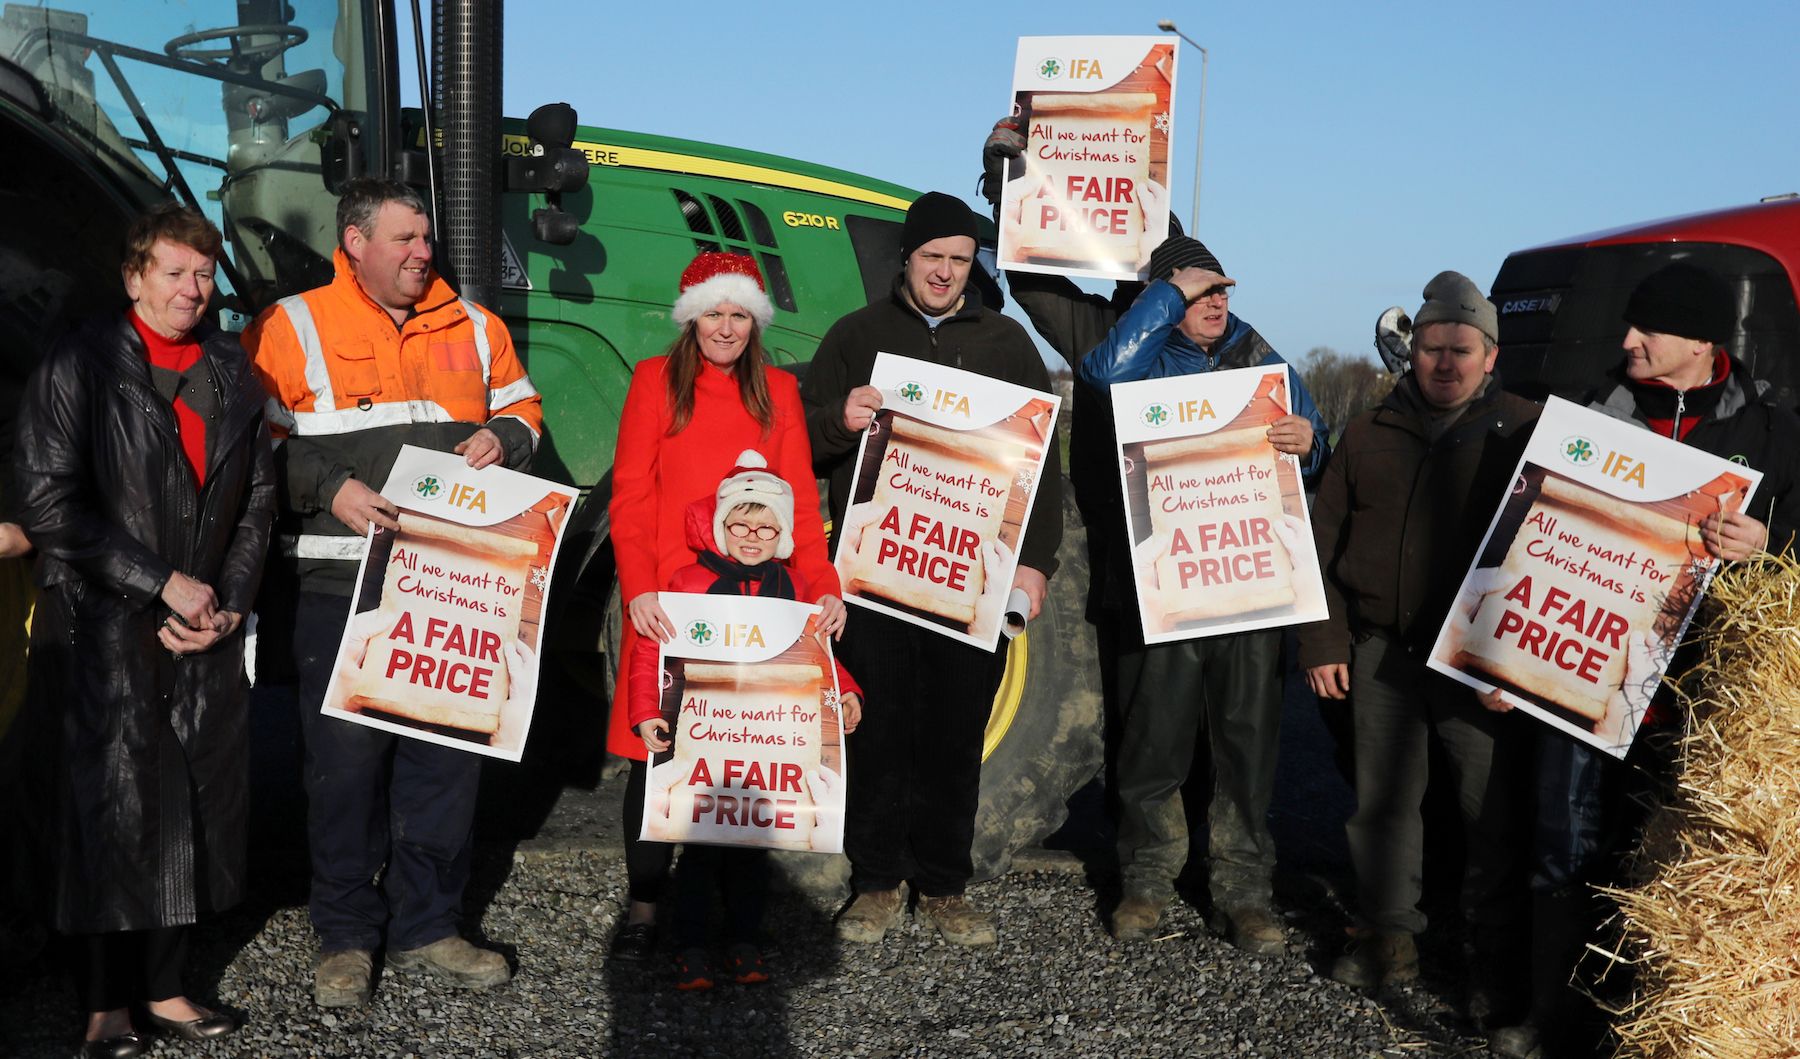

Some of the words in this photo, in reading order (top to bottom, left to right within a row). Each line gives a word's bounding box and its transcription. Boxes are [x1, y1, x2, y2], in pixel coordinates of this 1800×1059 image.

[1069, 59, 1103, 80] IFA
[1031, 124, 1052, 140] All
[1058, 132, 1077, 141] we
[1082, 128, 1119, 143] want
[1123, 128, 1146, 144] for
[1039, 144, 1119, 162] Christmas
[1125, 149, 1136, 163] is
[1037, 175, 1055, 199] A
[1067, 176, 1134, 203] FAIR
[783, 211, 824, 228] 6210
[825, 216, 840, 230] R
[1040, 205, 1128, 235] PICE
[1502, 299, 1538, 314] CASE
[932, 389, 970, 418] IFA
[1178, 399, 1216, 424] IFA
[886, 448, 909, 469] All
[912, 464, 931, 477] we
[936, 471, 976, 490] want
[980, 478, 1005, 499] for
[1151, 475, 1175, 492] All
[1179, 480, 1200, 490] we
[1205, 466, 1245, 487] want
[1248, 464, 1273, 481] for
[1601, 451, 1646, 489] IFA
[448, 483, 486, 514] IFA
[890, 473, 971, 513] Christmas
[976, 503, 989, 518] is
[1162, 491, 1249, 513] Christmas
[1254, 489, 1268, 502] is
[879, 506, 901, 535] A
[908, 513, 980, 560] FAIR
[1169, 528, 1194, 556] A
[1198, 517, 1274, 552] FAIR
[1526, 511, 1557, 536] All
[1558, 531, 1583, 548] we
[1587, 543, 1638, 569] want
[1641, 558, 1672, 585] for
[392, 548, 418, 570] All
[422, 565, 445, 577] we
[450, 572, 492, 589] want
[495, 576, 520, 597] for
[877, 537, 970, 592] PRICE
[1178, 550, 1275, 590] PRICE
[1526, 539, 1624, 594] Christmas
[1629, 584, 1646, 604] is
[397, 575, 488, 613] Christmas
[494, 602, 507, 618] is
[1504, 575, 1533, 609] A
[1538, 586, 1629, 650] FAIR
[388, 611, 415, 644] A
[424, 617, 502, 663] FAIR
[724, 623, 766, 648] IFA
[1493, 609, 1609, 684] PRICE
[385, 648, 494, 700] PRICE
[683, 697, 707, 717] All
[712, 708, 736, 720] we
[741, 705, 786, 722] want
[791, 705, 817, 723] for
[689, 722, 786, 746] Christmas
[792, 731, 807, 746] is
[688, 757, 714, 787] A
[723, 759, 803, 793] FAIR
[692, 794, 797, 829] PRICE
